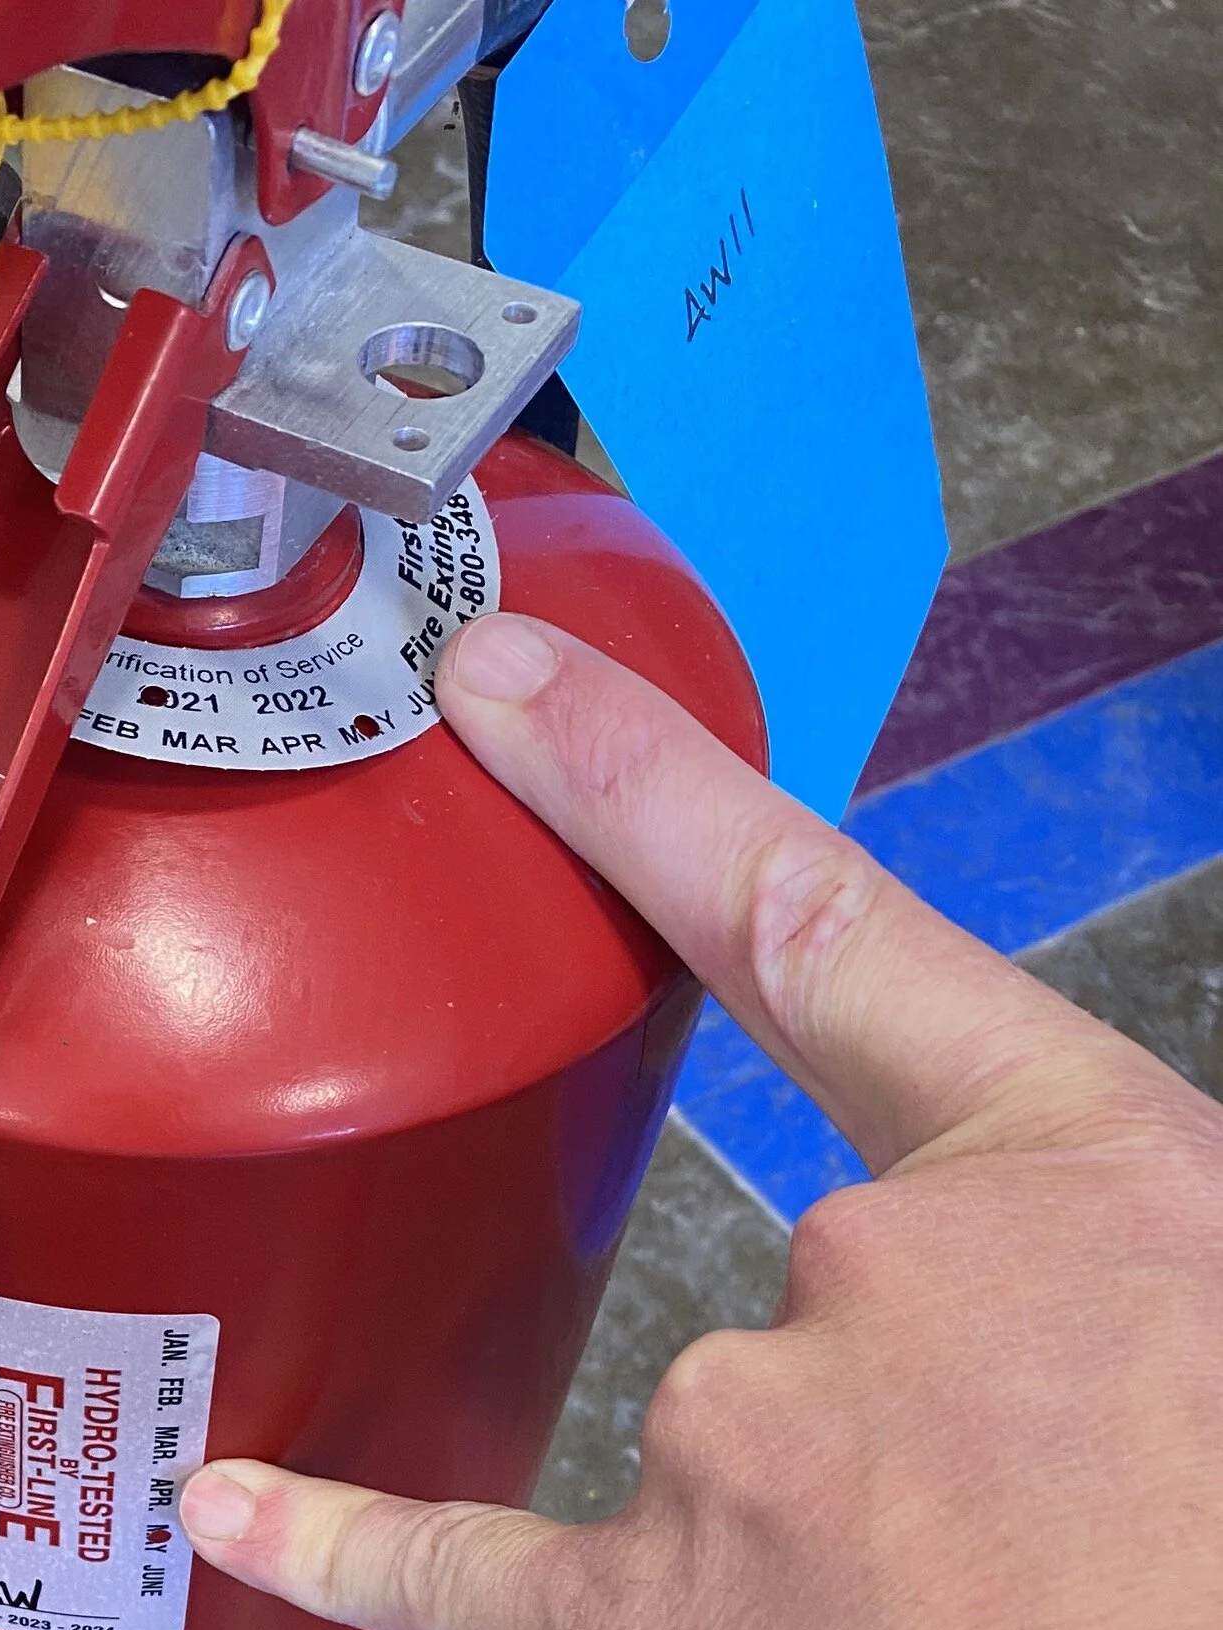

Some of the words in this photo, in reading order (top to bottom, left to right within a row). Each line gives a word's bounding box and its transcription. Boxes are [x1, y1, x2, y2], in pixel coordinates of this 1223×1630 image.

[399, 616, 444, 673] Fire
[427, 509, 455, 613] Exting
[106, 651, 234, 685] rification
[243, 664, 270, 684] of
[276, 633, 364, 679] Service
[252, 686, 334, 715] 2022
[162, 728, 238, 754] MAR
[261, 733, 326, 756] APR
[338, 709, 396, 746] MY
[161, 1329, 189, 1367] JAN.
[157, 1377, 185, 1412] FEB.
[151, 1426, 181, 1465] MAR.
[58, 1457, 80, 1480] BY
[76, 1366, 123, 1564] HYDRO-TESTED
[147, 1478, 175, 1512] APR.
[144, 1524, 171, 1554] MY
[140, 1564, 166, 1598] JUNE
[8, 1614, 52, 1630] 2023
